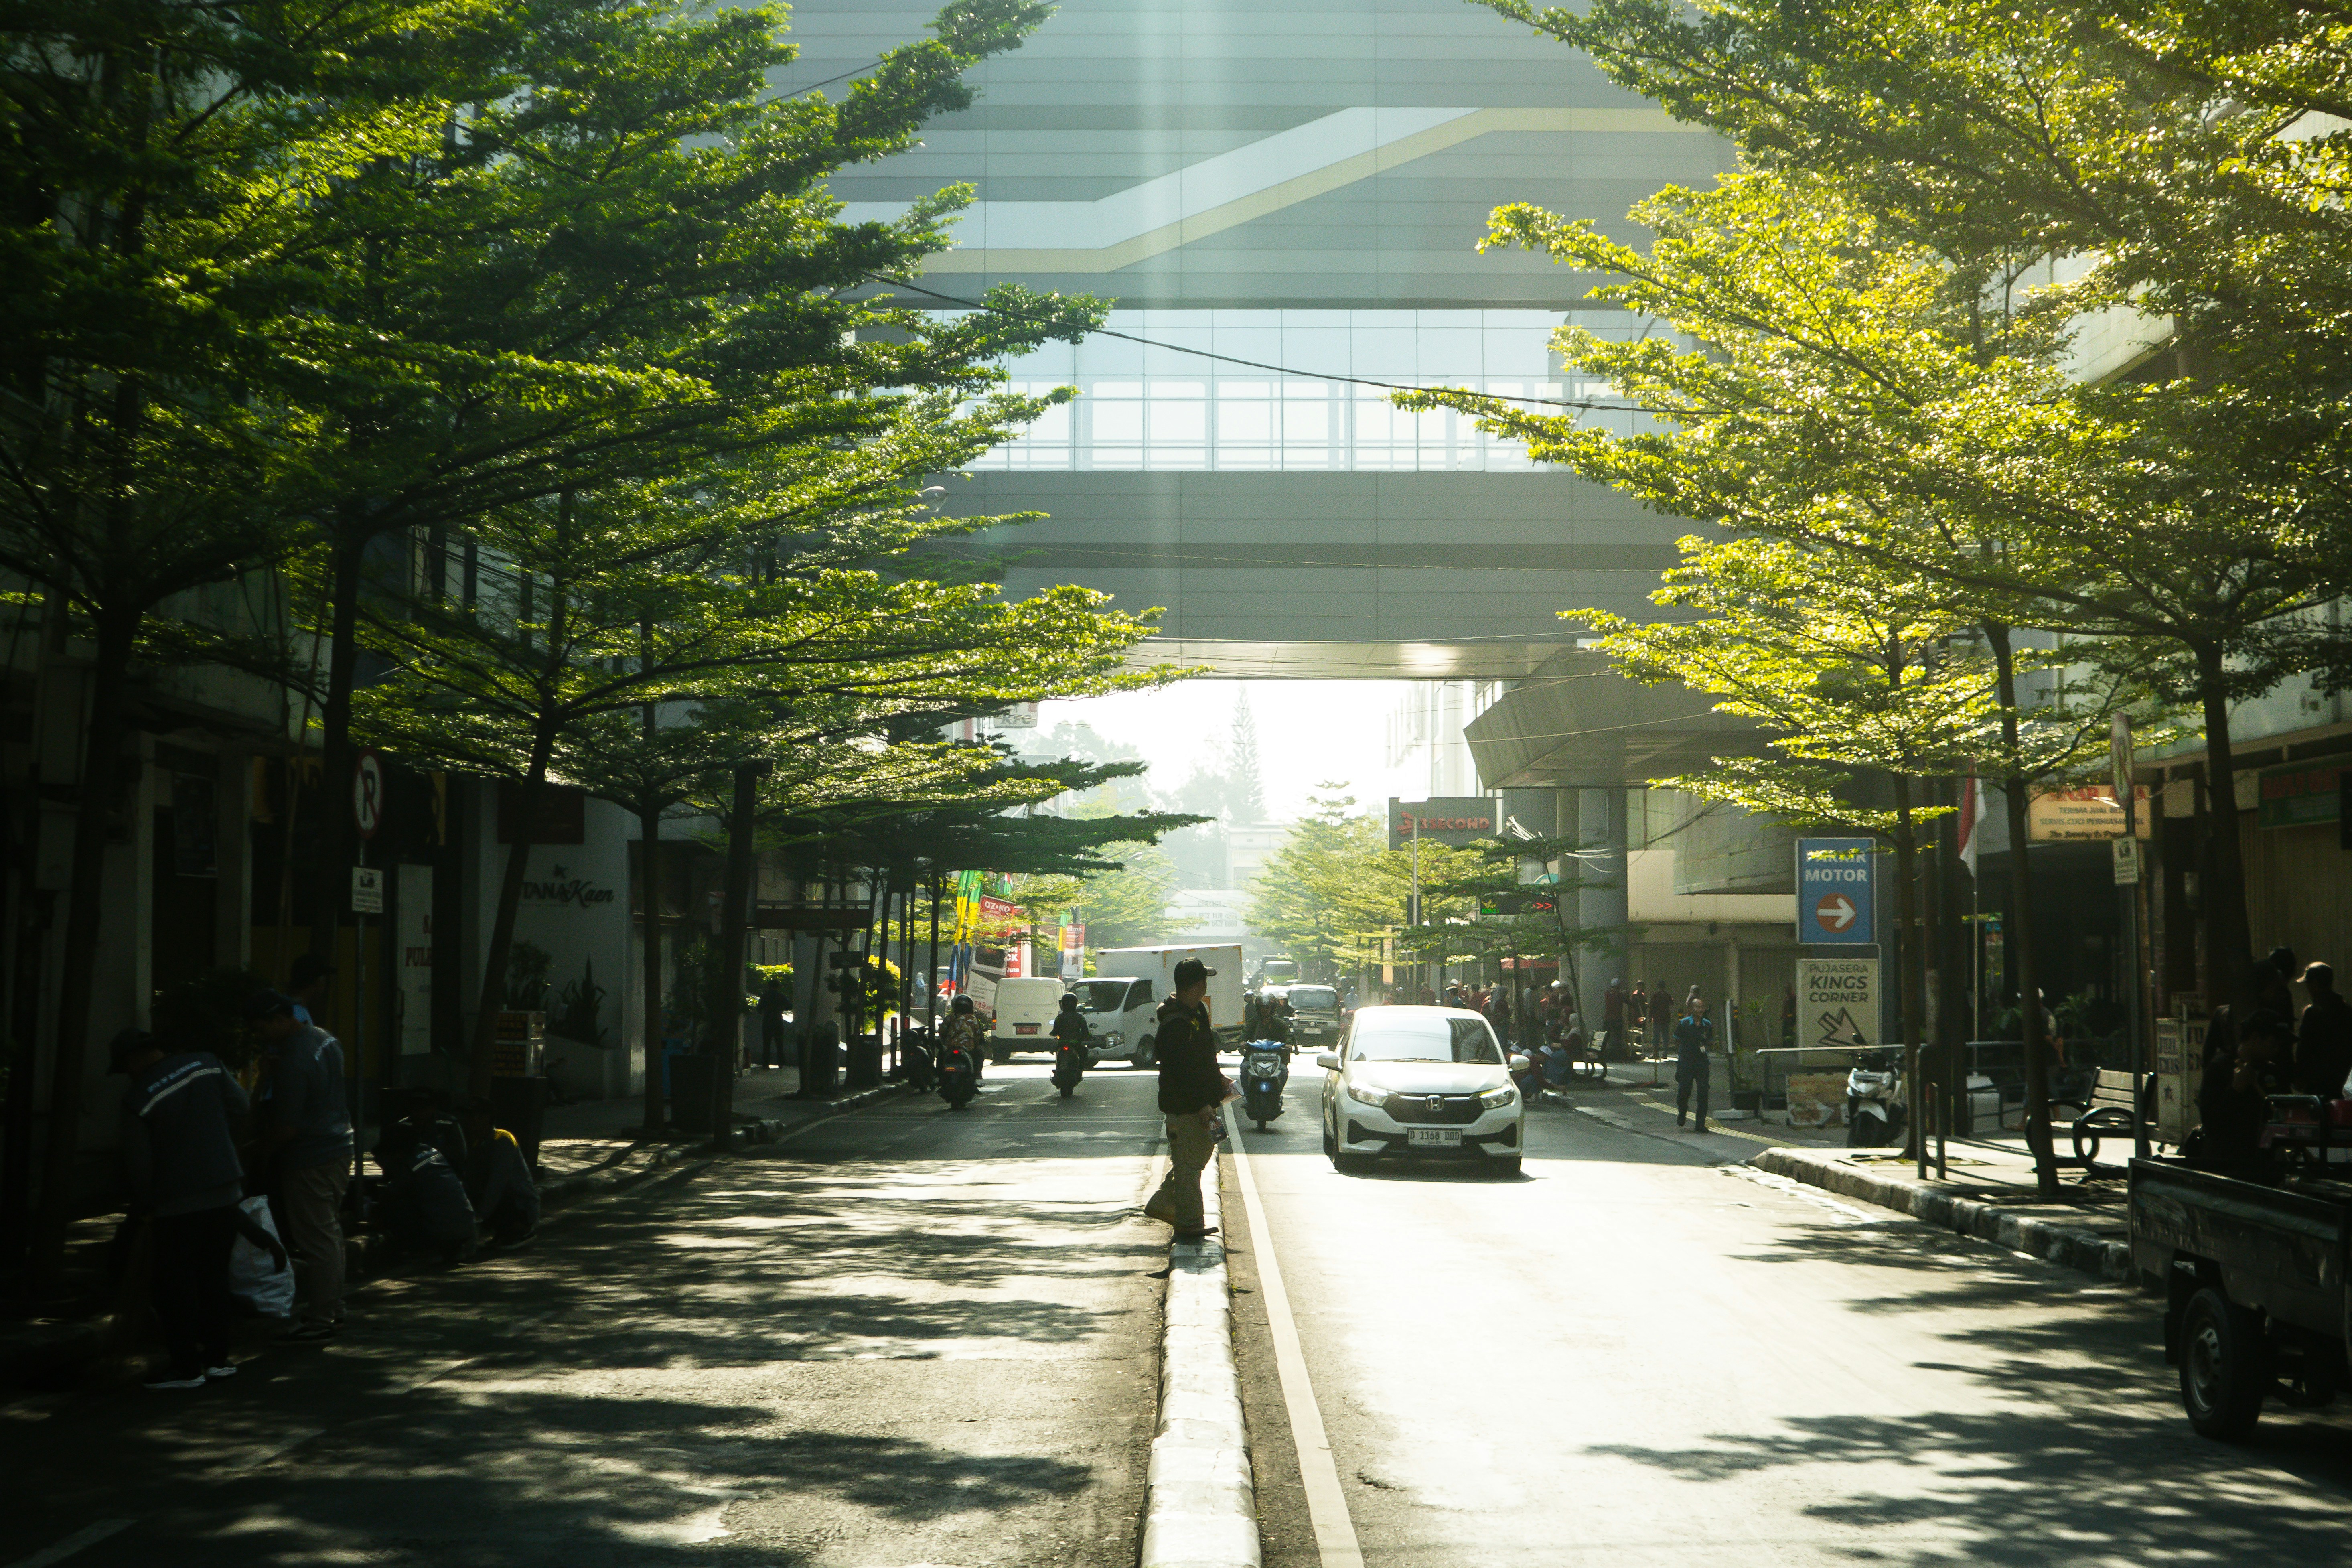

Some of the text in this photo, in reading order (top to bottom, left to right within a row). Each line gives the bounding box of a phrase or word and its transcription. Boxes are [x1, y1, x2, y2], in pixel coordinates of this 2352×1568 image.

[1000, 714, 1031, 724] KFC
[1419, 817, 1490, 830] 3SECOND
[1805, 869, 1867, 882] MOTOR
[1809, 964, 1869, 973] PUJASERA
[1809, 975, 1868, 989] KINGS
[1809, 992, 1869, 1003] CORNER
[1409, 1130, 1415, 1140] D
